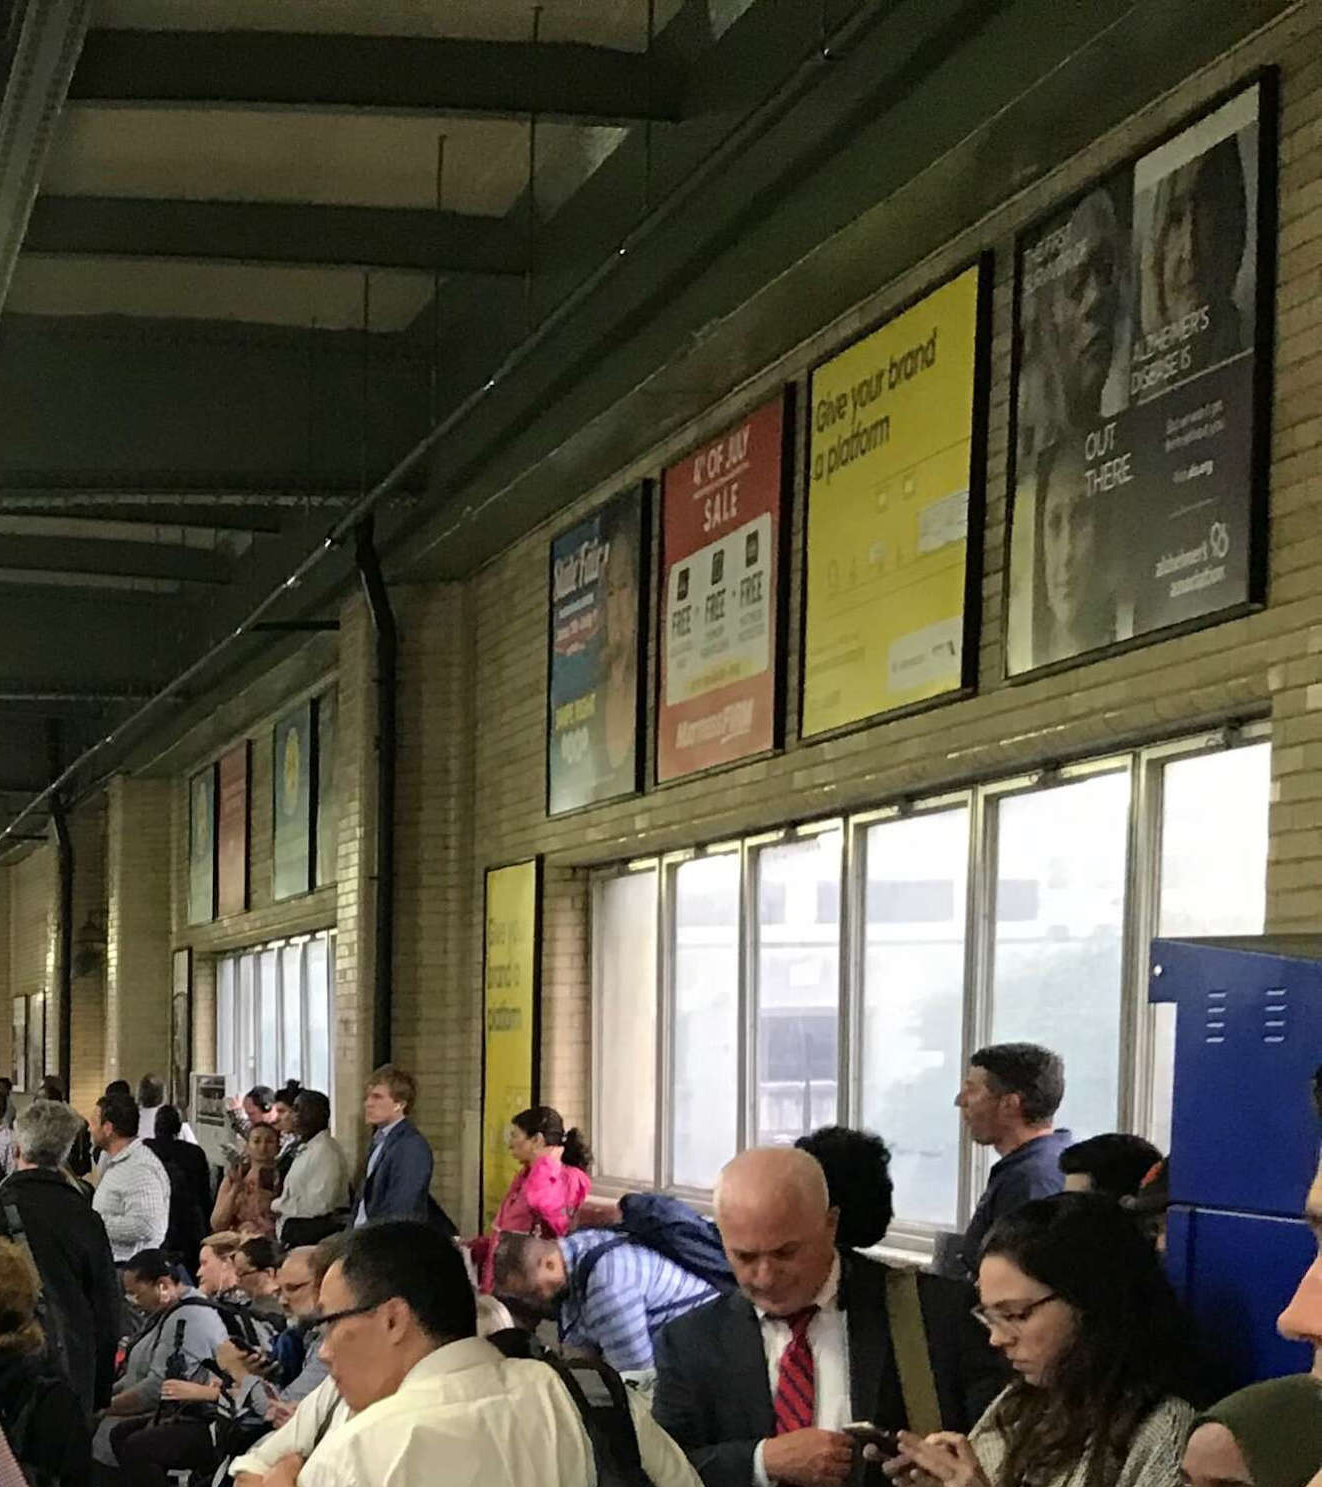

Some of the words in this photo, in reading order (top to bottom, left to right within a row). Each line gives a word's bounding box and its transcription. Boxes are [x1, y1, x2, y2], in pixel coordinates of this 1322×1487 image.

[816, 390, 848, 433] Give
[851, 368, 886, 432] your
[888, 325, 938, 390] brand
[707, 443, 724, 479] OF
[812, 452, 824, 482] a
[826, 415, 890, 486] platform
[1084, 421, 1118, 462] OUT
[1084, 452, 1135, 498] THERE
[703, 481, 739, 533] SALE
[705, 587, 726, 625] FREE
[740, 569, 764, 608] FREE
